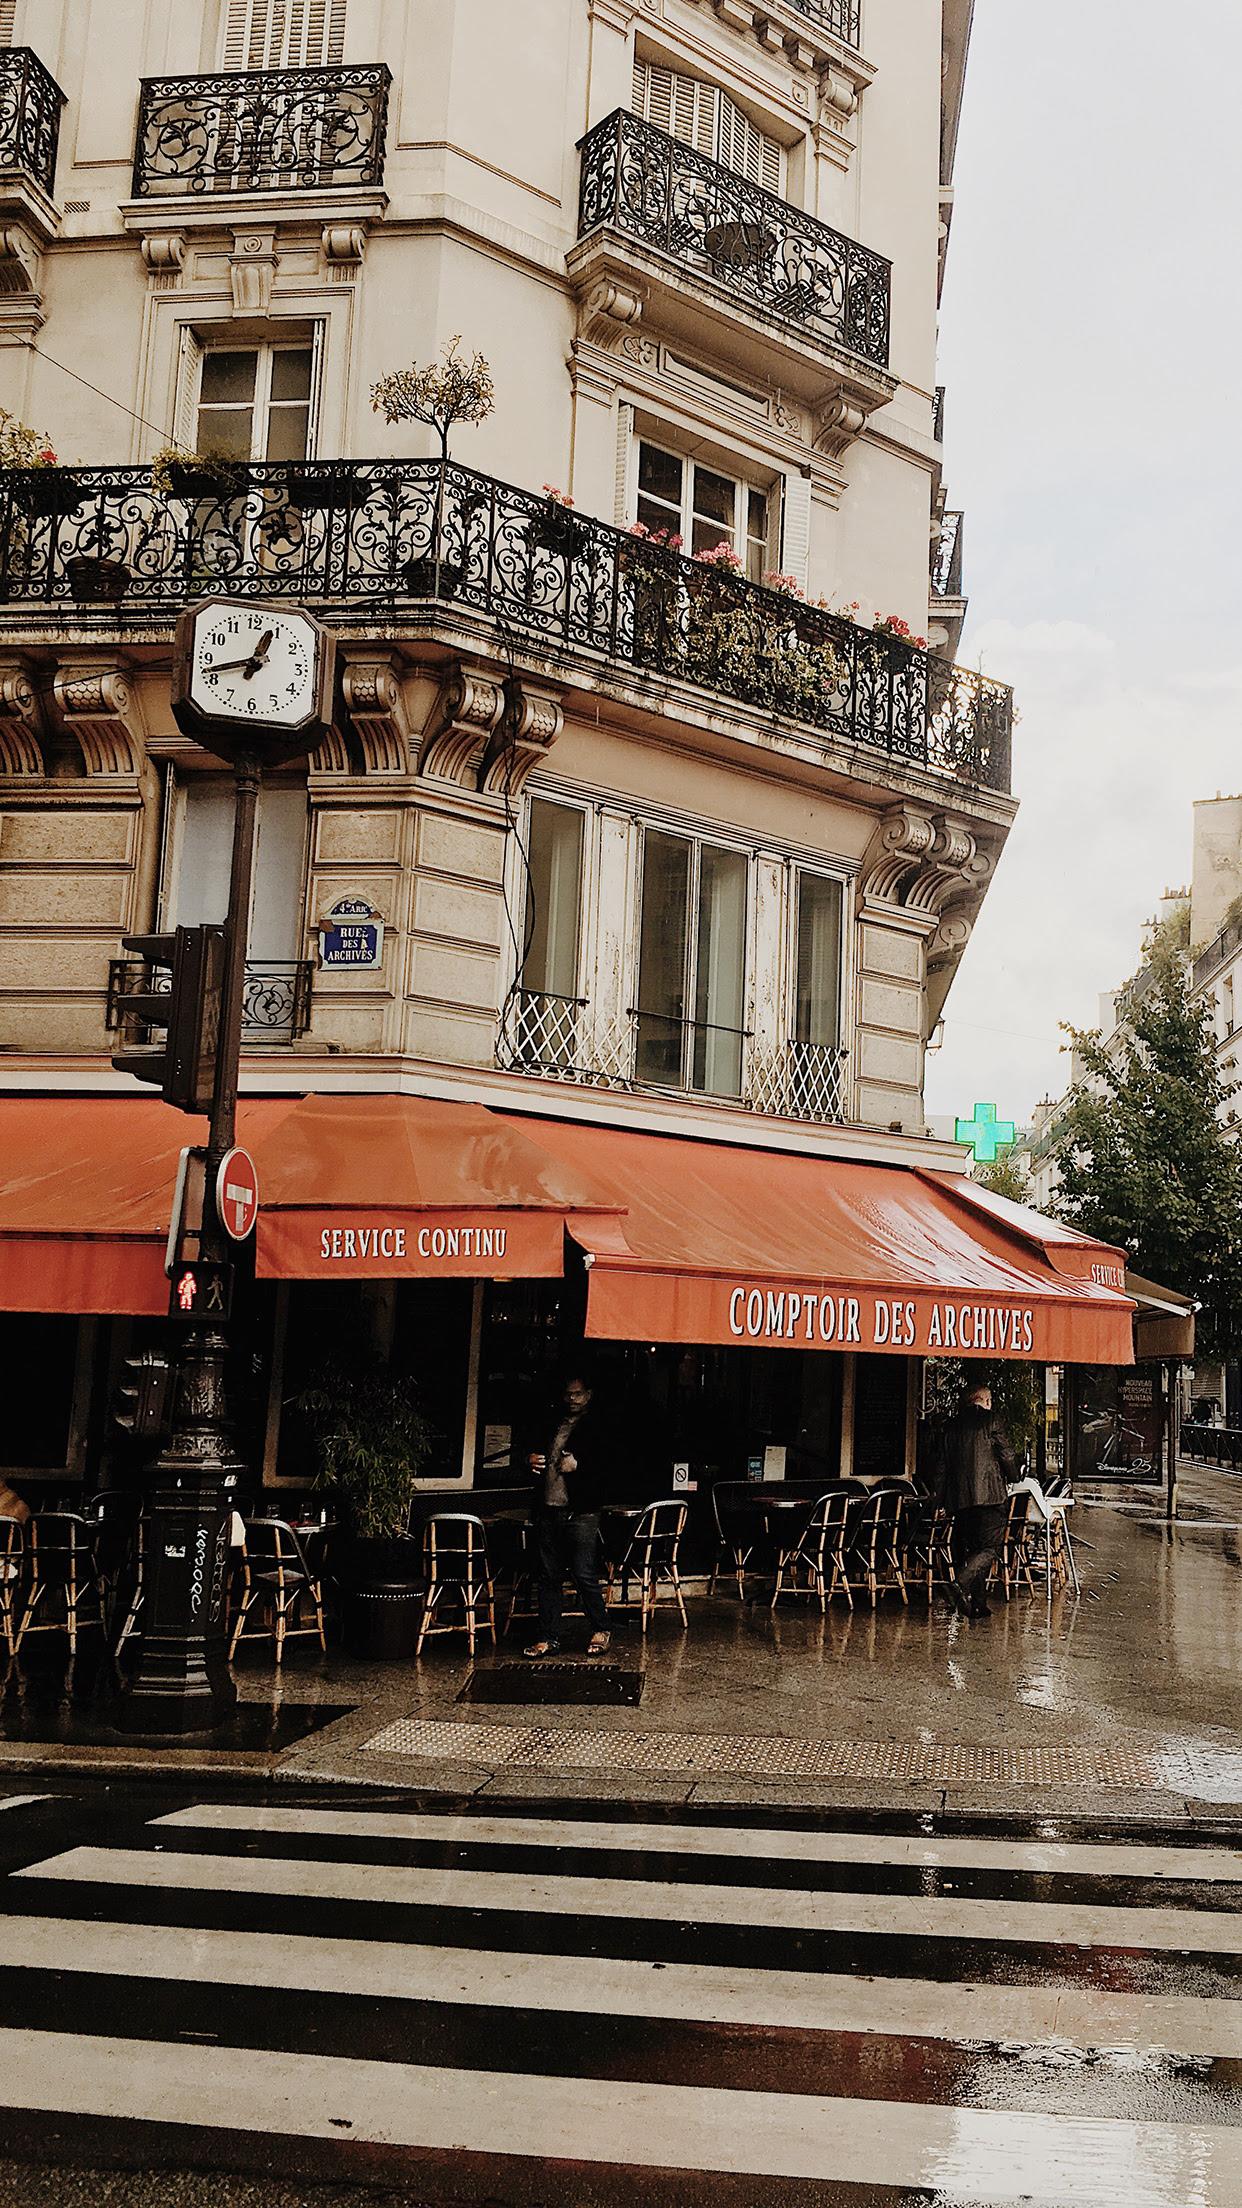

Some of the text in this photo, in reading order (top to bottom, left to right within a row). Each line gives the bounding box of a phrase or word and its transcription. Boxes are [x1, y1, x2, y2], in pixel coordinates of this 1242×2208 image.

[227, 620, 240, 634] 11
[247, 617, 263, 631] 12
[211, 632, 226, 646] 10
[274, 627, 281, 639] 1
[288, 642, 297, 655] 2
[204, 652, 213, 665] 9
[294, 663, 303, 676] 3
[209, 673, 219, 685] 8
[226, 688, 235, 701] 7
[285, 682, 297, 695] 4
[247, 698, 257, 711] 6
[269, 694, 278, 707] 5
[340, 927, 364, 938] RUE
[342, 939, 359, 948] DES
[327, 950, 374, 961] ARCHIVES
[320, 1228, 507, 1259] SERVICE CONTINU
[1091, 1263, 1117, 1287] SERVICE
[729, 1287, 1034, 1351] COMPTOIR DES ARCHIVES
